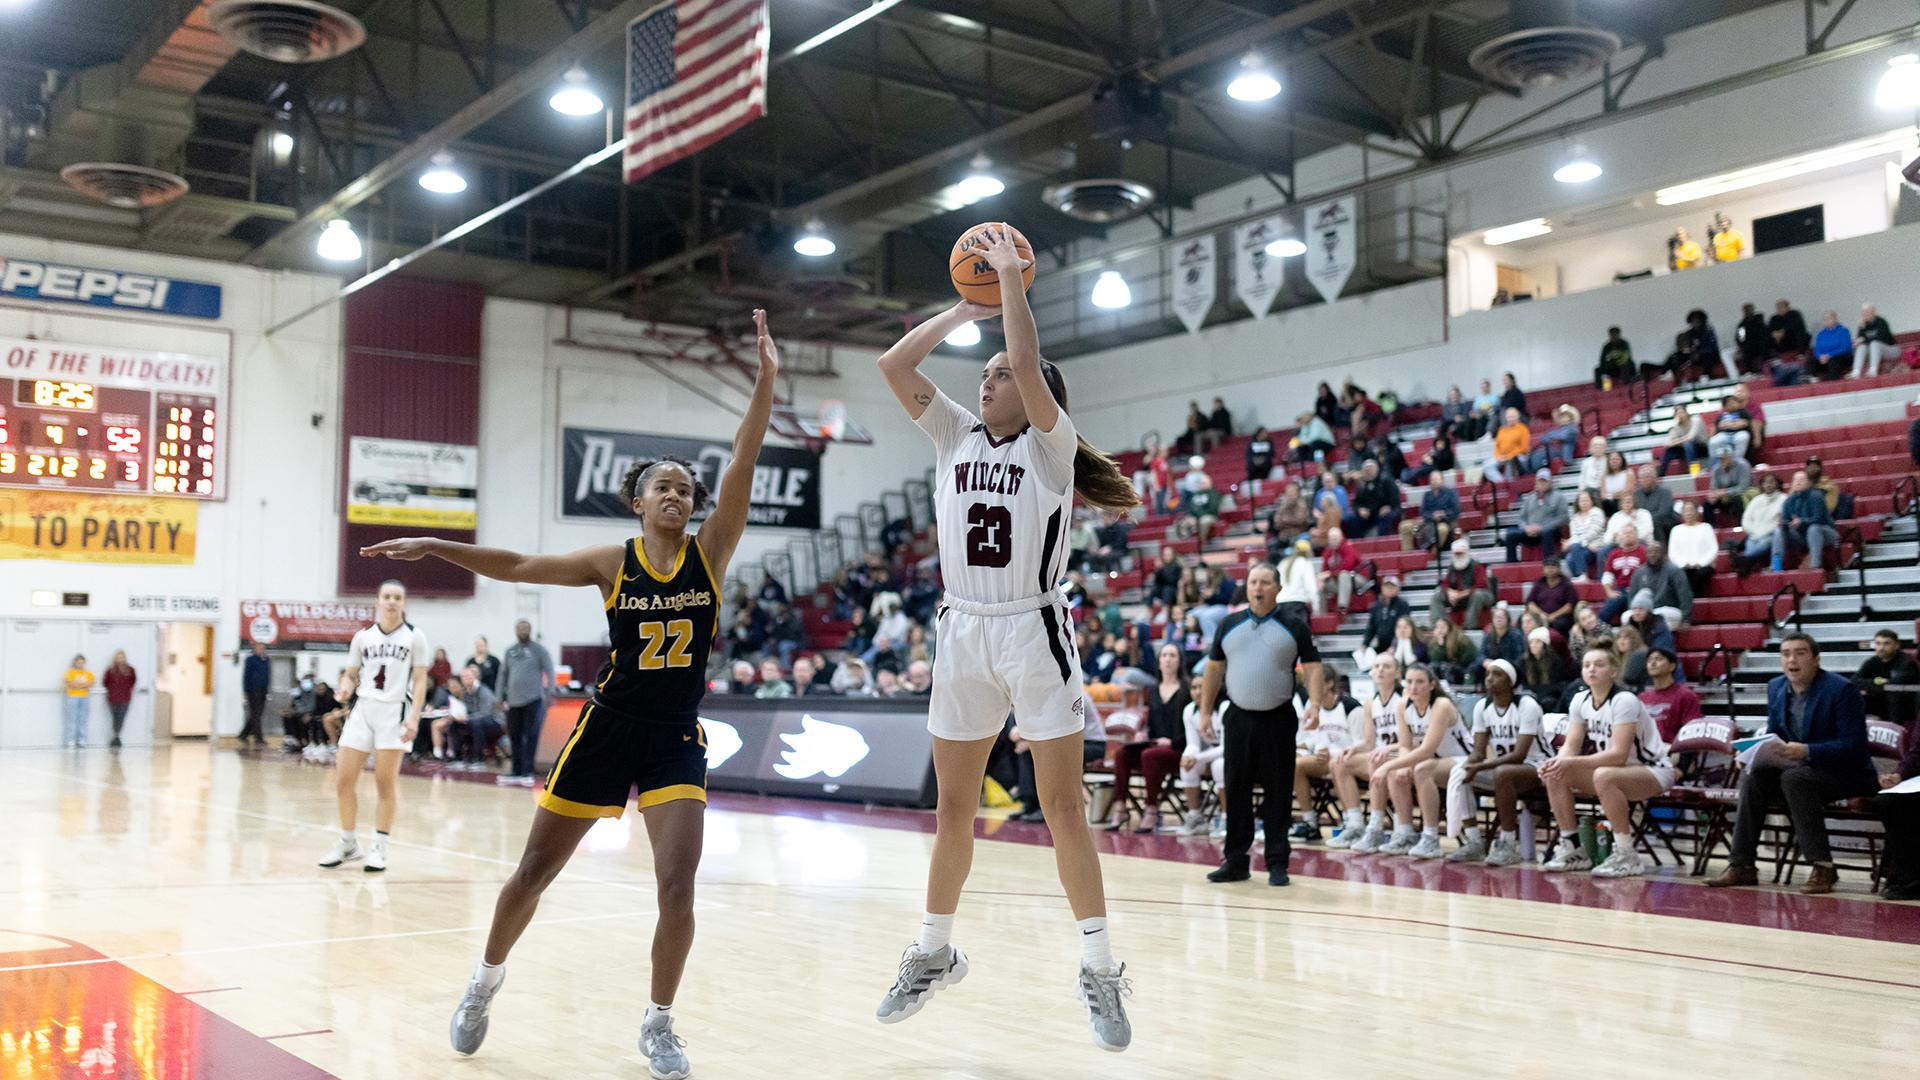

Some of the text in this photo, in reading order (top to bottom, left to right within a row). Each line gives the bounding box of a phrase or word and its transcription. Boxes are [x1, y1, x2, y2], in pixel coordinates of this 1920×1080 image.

[2, 260, 170, 310] PEPSI
[7, 347, 215, 386] OF THE WILDCATS!
[34, 380, 94, 410] 8:25
[106, 426, 141, 453] 52
[31, 513, 182, 552] TO PARTY
[966, 502, 1013, 569] 23
[128, 594, 221, 613] BUTTE STRONG
[242, 602, 376, 622] GO WILDCATS!
[619, 588, 712, 612] Los Angeles
[638, 618, 694, 671] 22
[373, 664, 386, 690] 4
[1705, 722, 1731, 742] STATE
[1868, 726, 1900, 748] STATE
